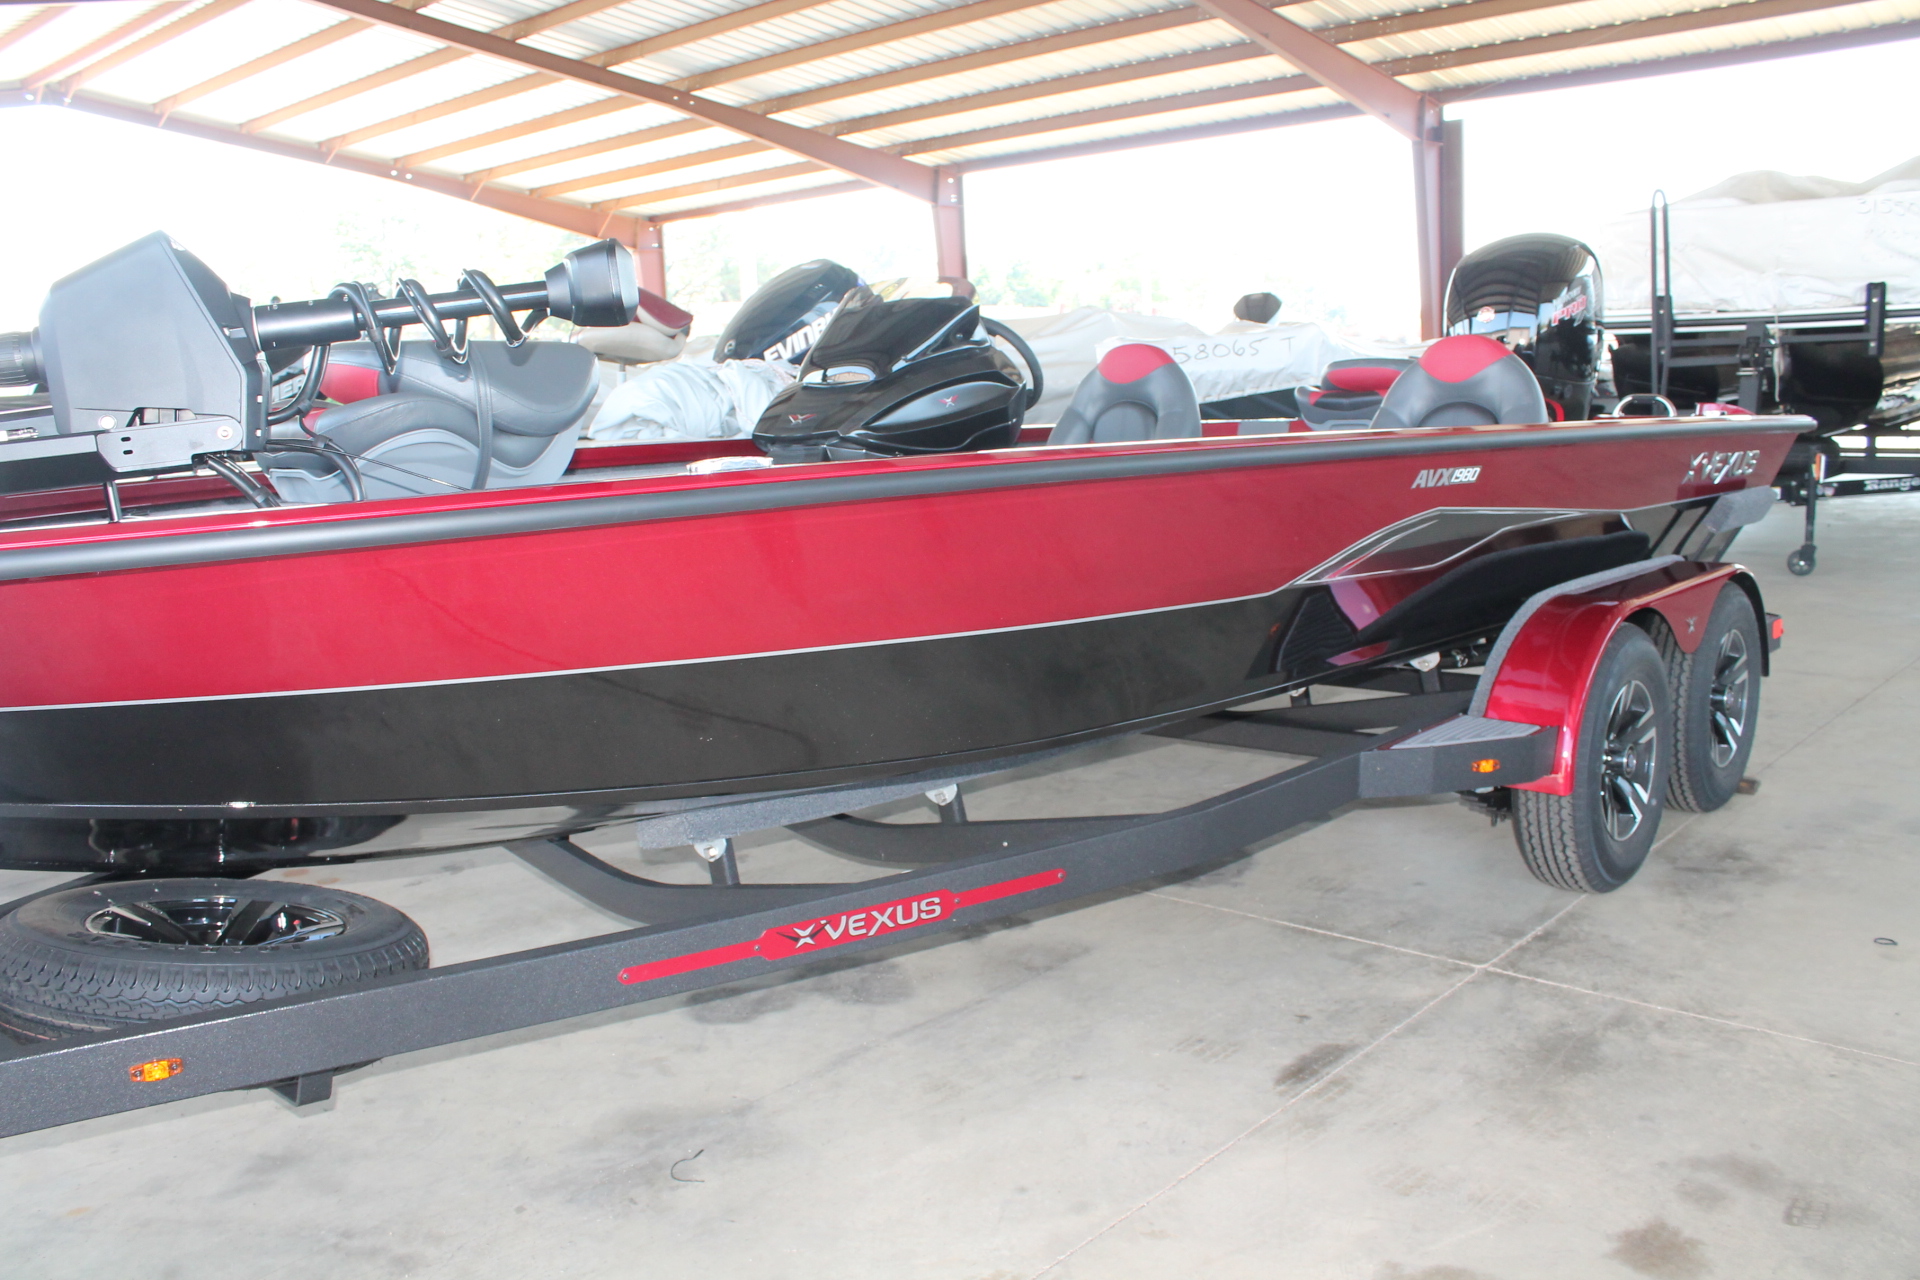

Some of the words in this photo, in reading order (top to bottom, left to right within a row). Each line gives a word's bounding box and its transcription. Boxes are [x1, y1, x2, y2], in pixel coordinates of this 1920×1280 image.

[763, 307, 839, 362] EVINR
[1172, 336, 1268, 364] 58065
[820, 897, 942, 940] VEXUS
